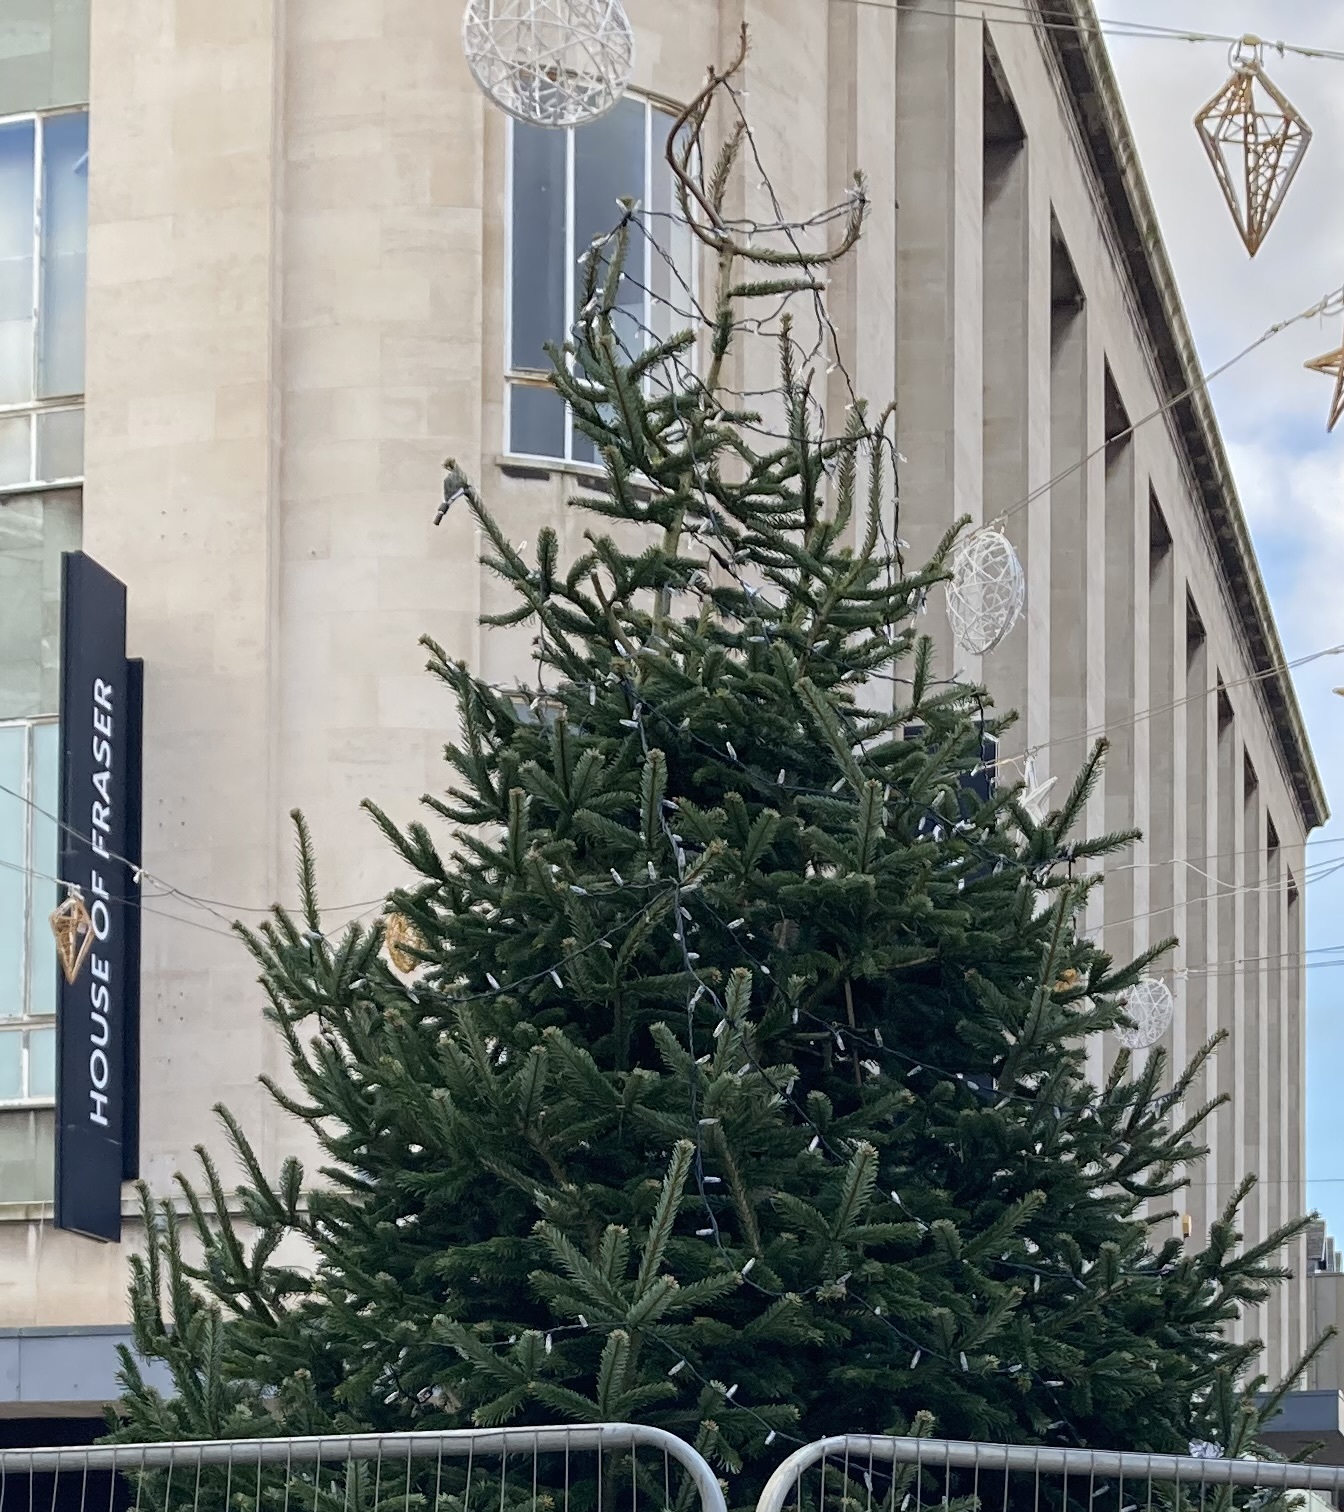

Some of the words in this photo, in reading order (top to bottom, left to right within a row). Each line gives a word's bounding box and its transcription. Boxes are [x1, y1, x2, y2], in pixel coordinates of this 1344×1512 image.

[92, 677, 113, 860] FRASER
[91, 869, 110, 941] OF
[89, 953, 110, 1127] HOUSE
